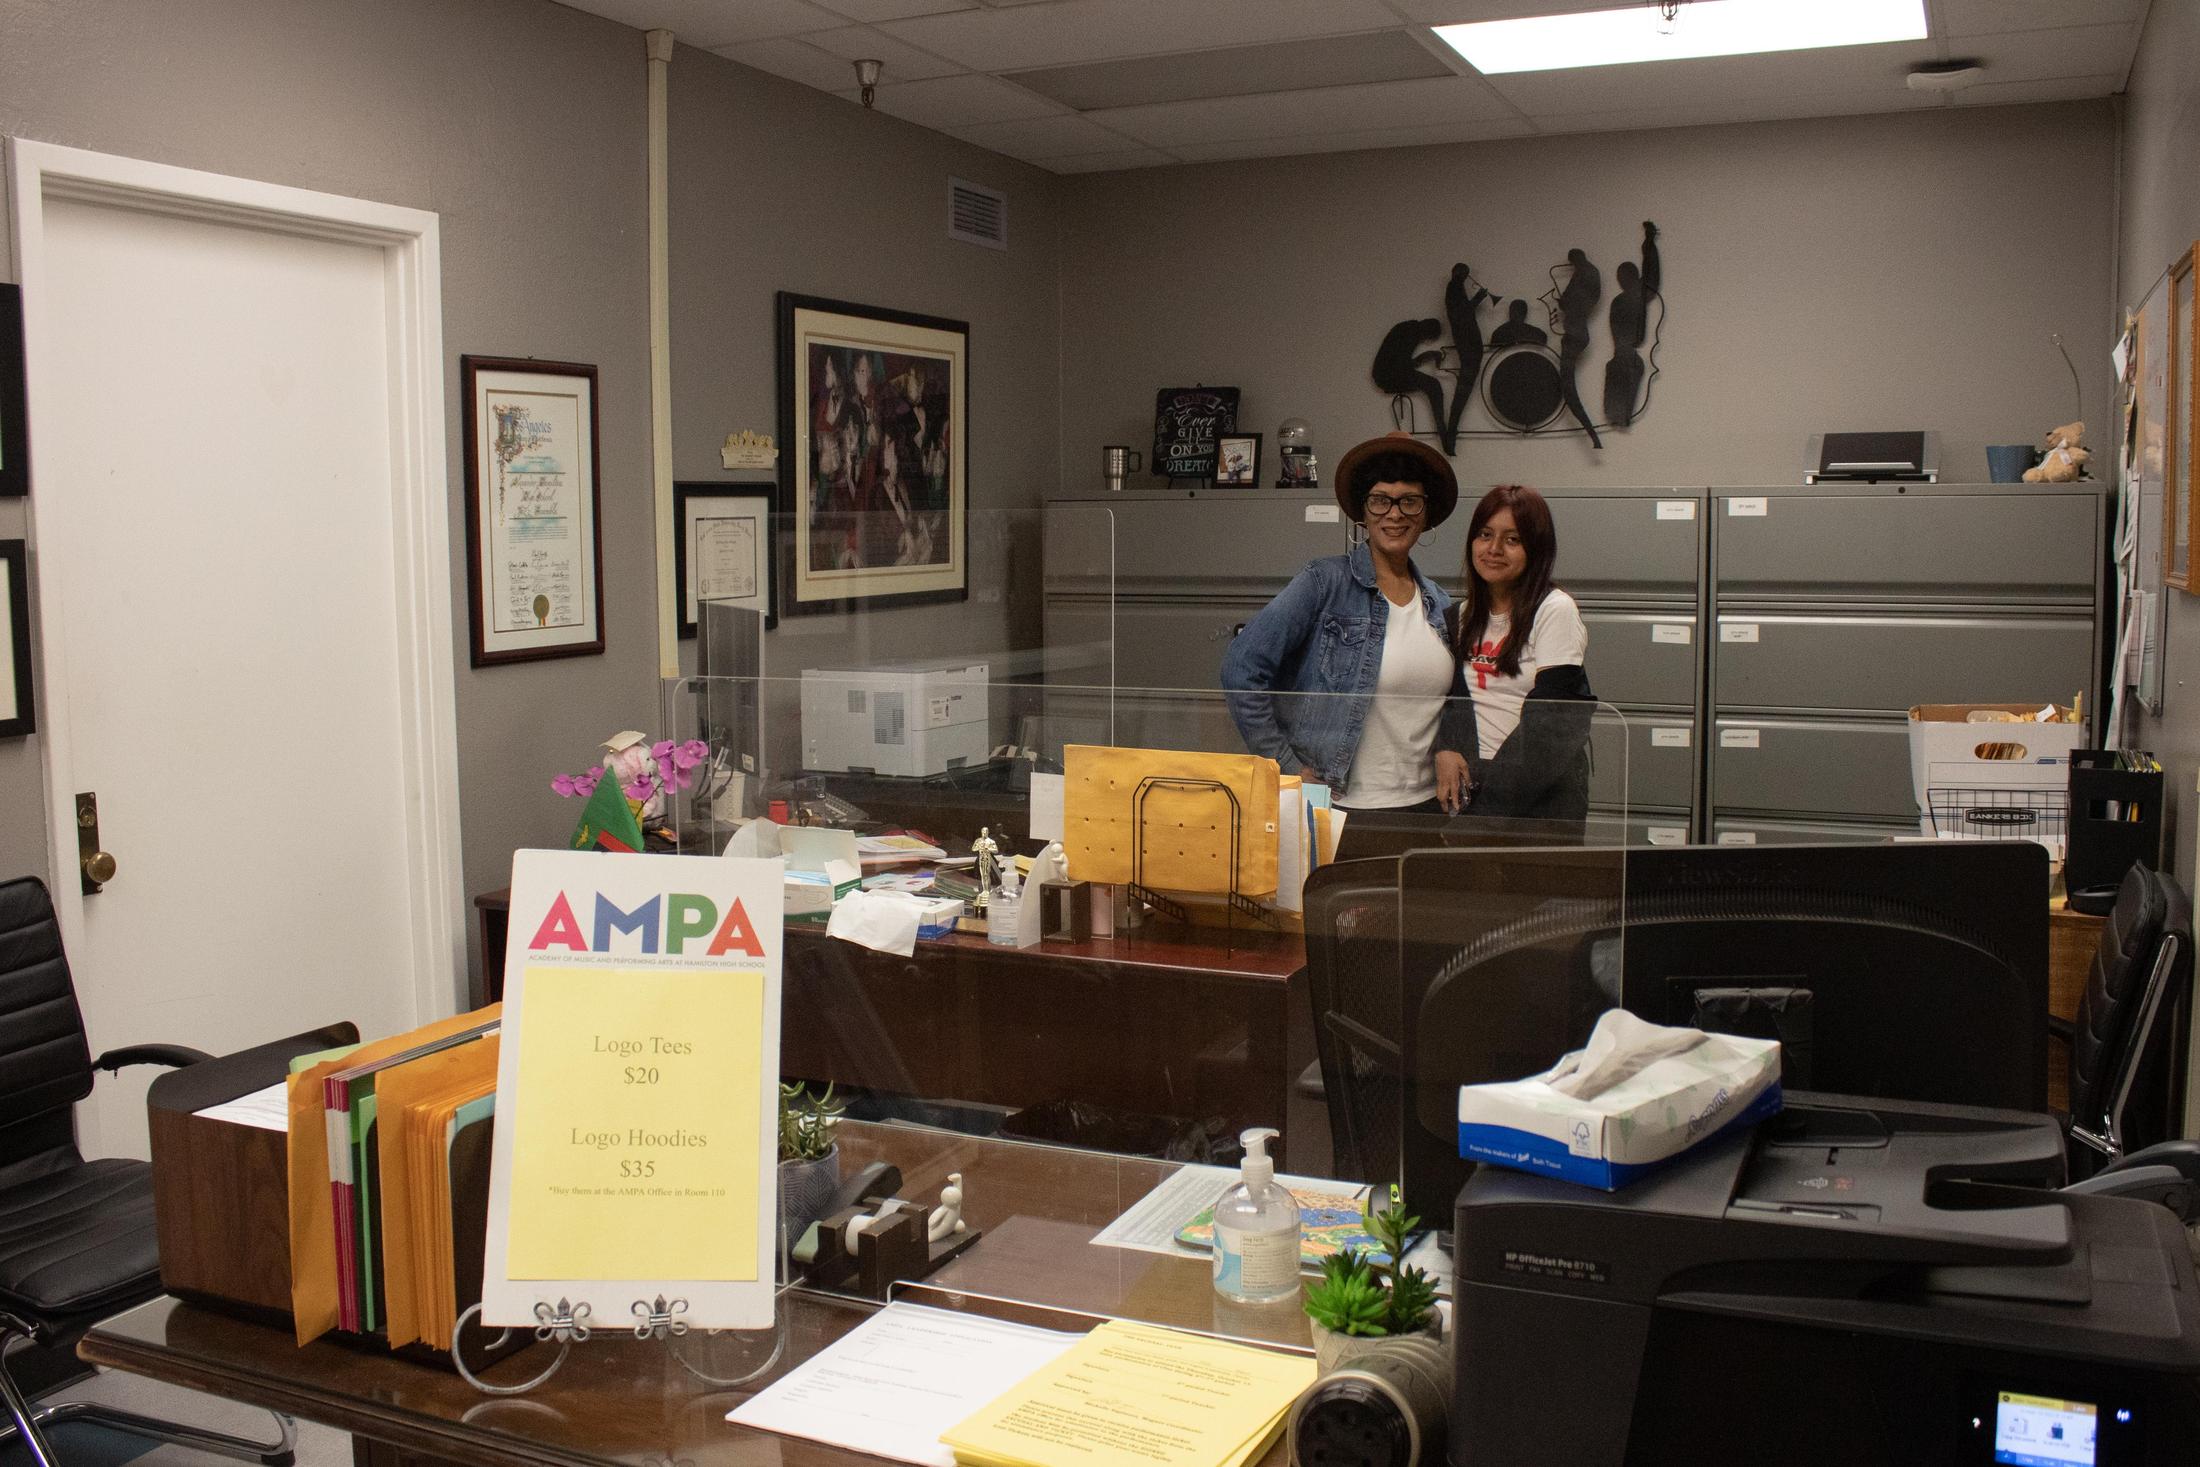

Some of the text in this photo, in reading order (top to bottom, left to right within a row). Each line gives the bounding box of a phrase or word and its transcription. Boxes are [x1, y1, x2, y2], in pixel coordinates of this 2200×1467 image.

[1170, 445, 1193, 457] ON
[528, 889, 766, 957] AMPA
[529, 954, 561, 962] ACADEMY
[613, 957, 657, 965] PERFORMING
[658, 958, 673, 966] ARTS
[720, 960, 737, 968] HIGH
[738, 961, 766, 969] SCHOOL
[593, 1035, 692, 1058] Logo Tees
[623, 1066, 660, 1086] $20
[570, 1127, 708, 1150] Logo Hoodies
[1483, 1147, 1492, 1155] the
[620, 1159, 656, 1179] $35
[571, 1186, 592, 1196] them
[593, 1188, 602, 1196] at
[603, 1187, 616, 1196] the
[617, 1187, 645, 1197] AMPA
[647, 1187, 673, 1197] Office
[674, 1188, 683, 1197] in
[684, 1188, 709, 1197] Room
[711, 1188, 726, 1197] 110
[1505, 1252, 1596, 1271] HP OfficeJet Pro 8710
